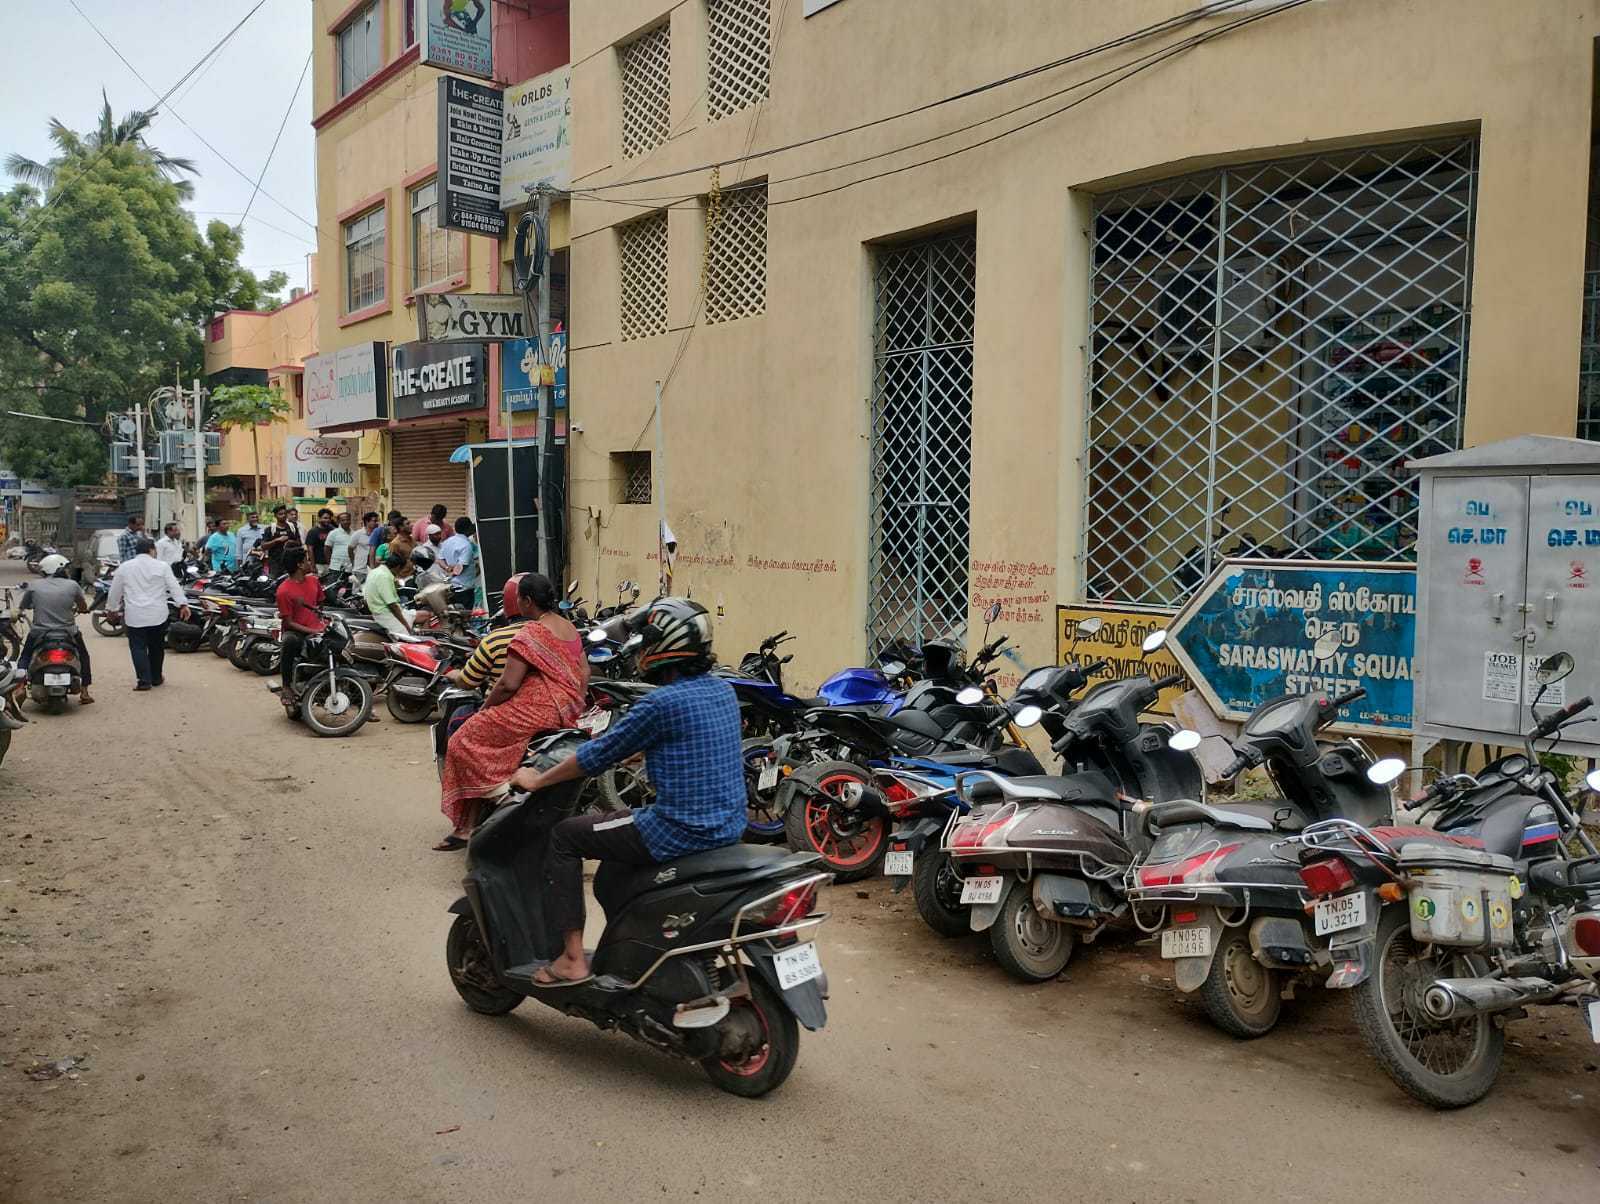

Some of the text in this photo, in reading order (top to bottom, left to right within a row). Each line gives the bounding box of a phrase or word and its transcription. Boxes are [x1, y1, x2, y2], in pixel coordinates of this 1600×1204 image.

[484, 184, 494, 192] Art
[459, 311, 524, 336] GYM
[330, 468, 354, 484] foods
[1233, 579, 1322, 620] சரஸ்வதி
[1219, 644, 1348, 675] SARASWATHY
[1490, 654, 1517, 665] JOB
